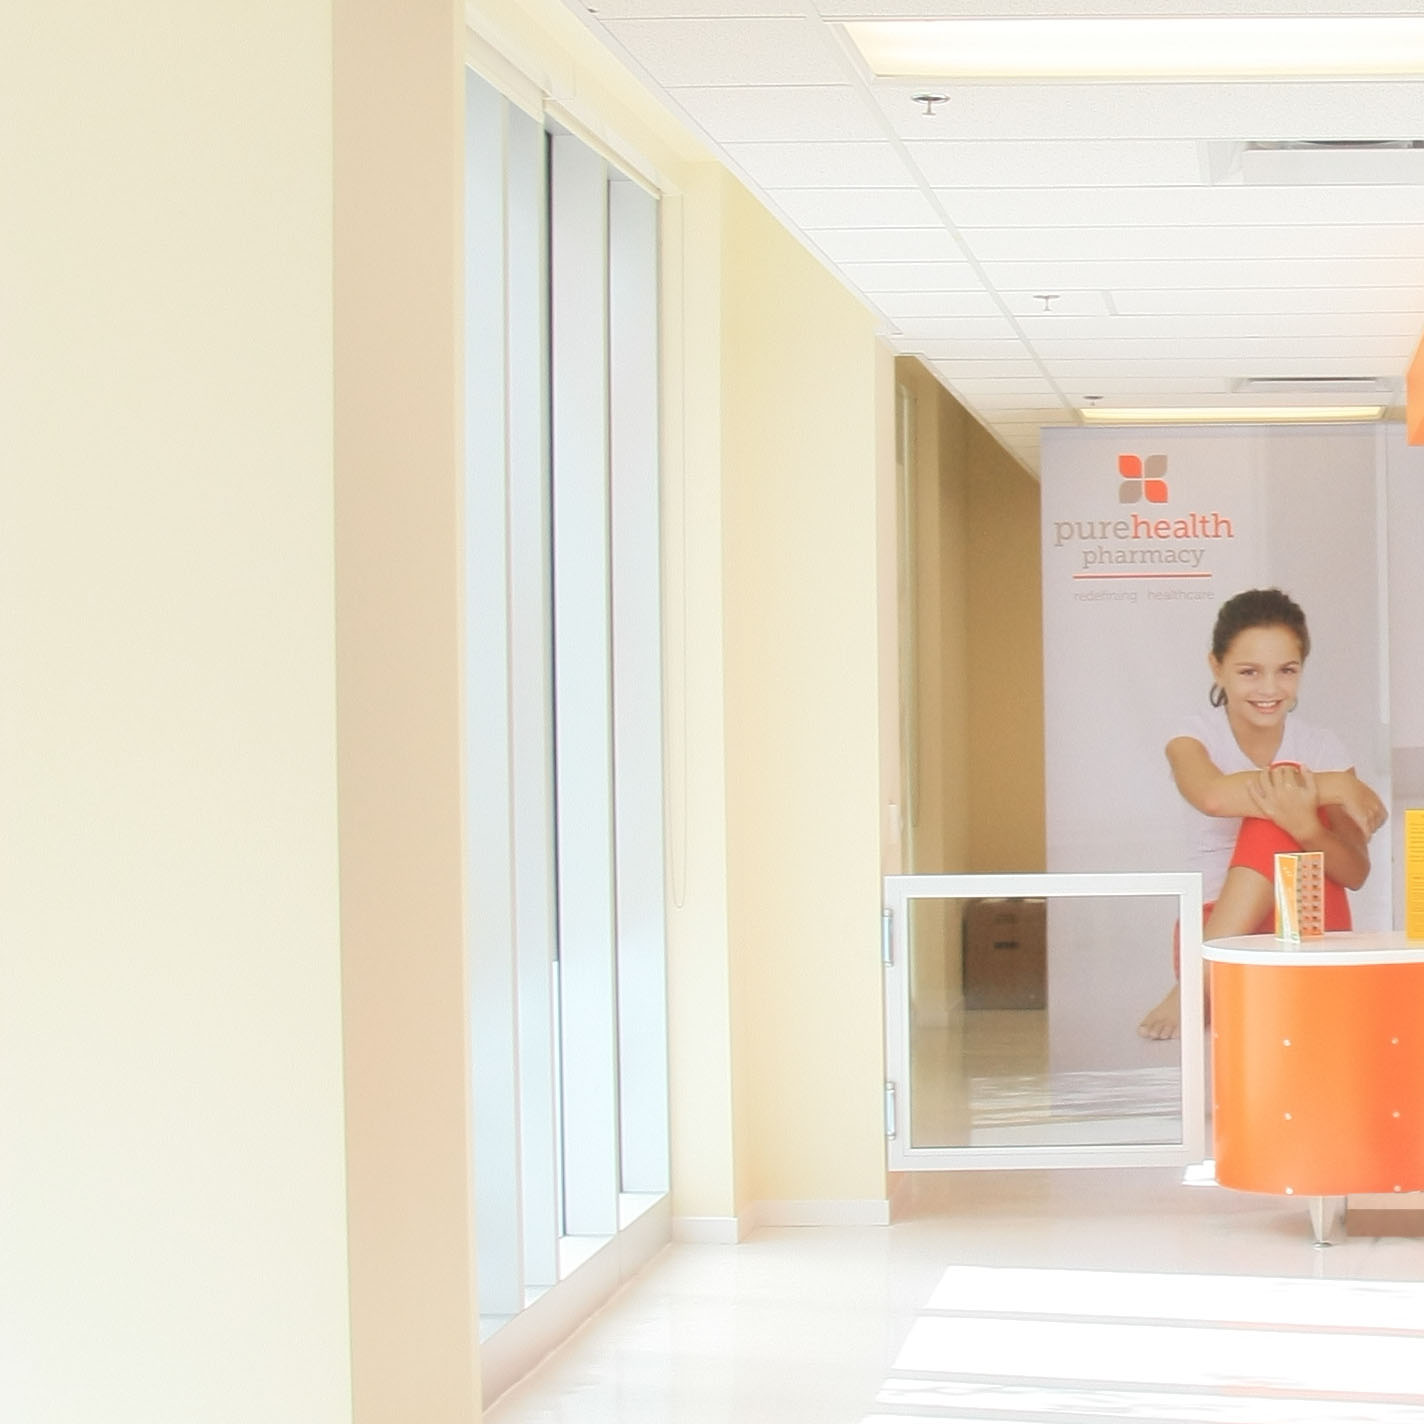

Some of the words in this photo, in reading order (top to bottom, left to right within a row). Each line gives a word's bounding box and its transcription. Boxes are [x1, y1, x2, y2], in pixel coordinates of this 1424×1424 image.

[1054, 512, 1235, 547] purehealth
[1082, 545, 1205, 568] pharmacy
[1147, 589, 1216, 601] healthcare
